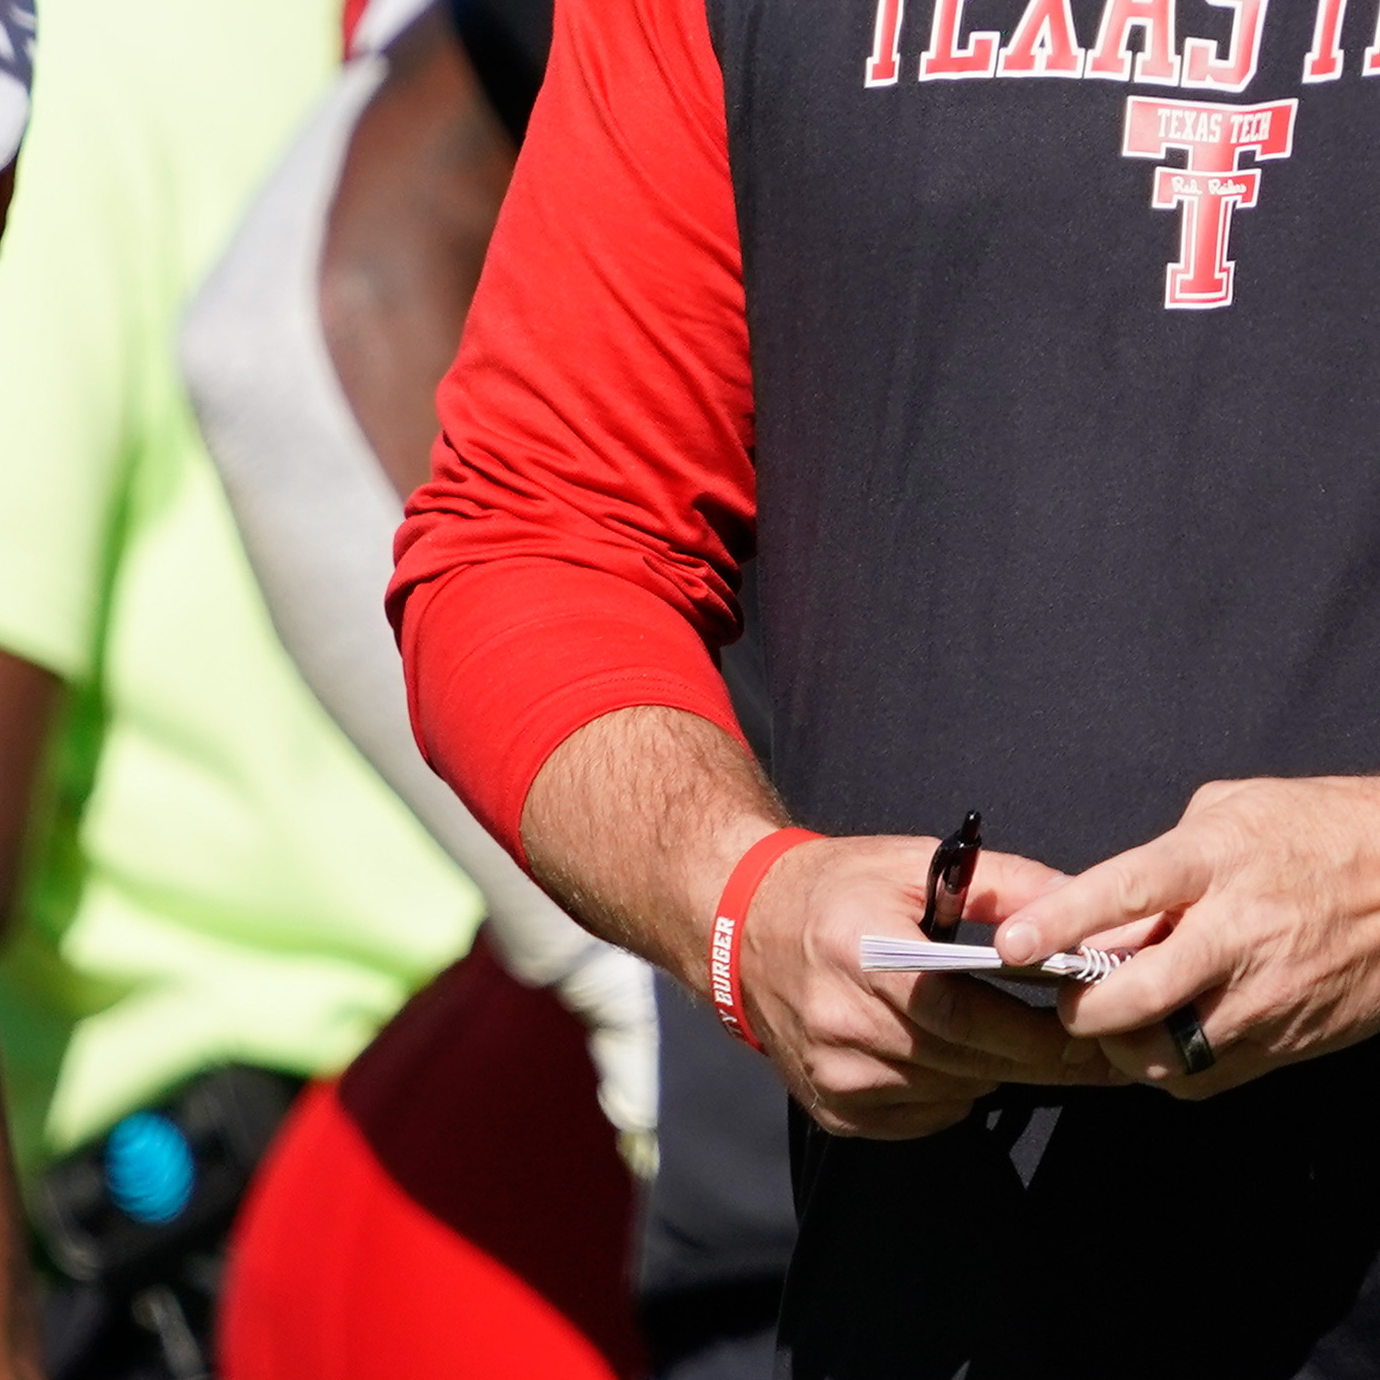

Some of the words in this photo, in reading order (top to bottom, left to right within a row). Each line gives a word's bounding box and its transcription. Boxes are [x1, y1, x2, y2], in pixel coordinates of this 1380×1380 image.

[1157, 108, 1223, 144] TEXAS
[1230, 110, 1273, 144] TECH
[711, 916, 736, 1006] BURGER
